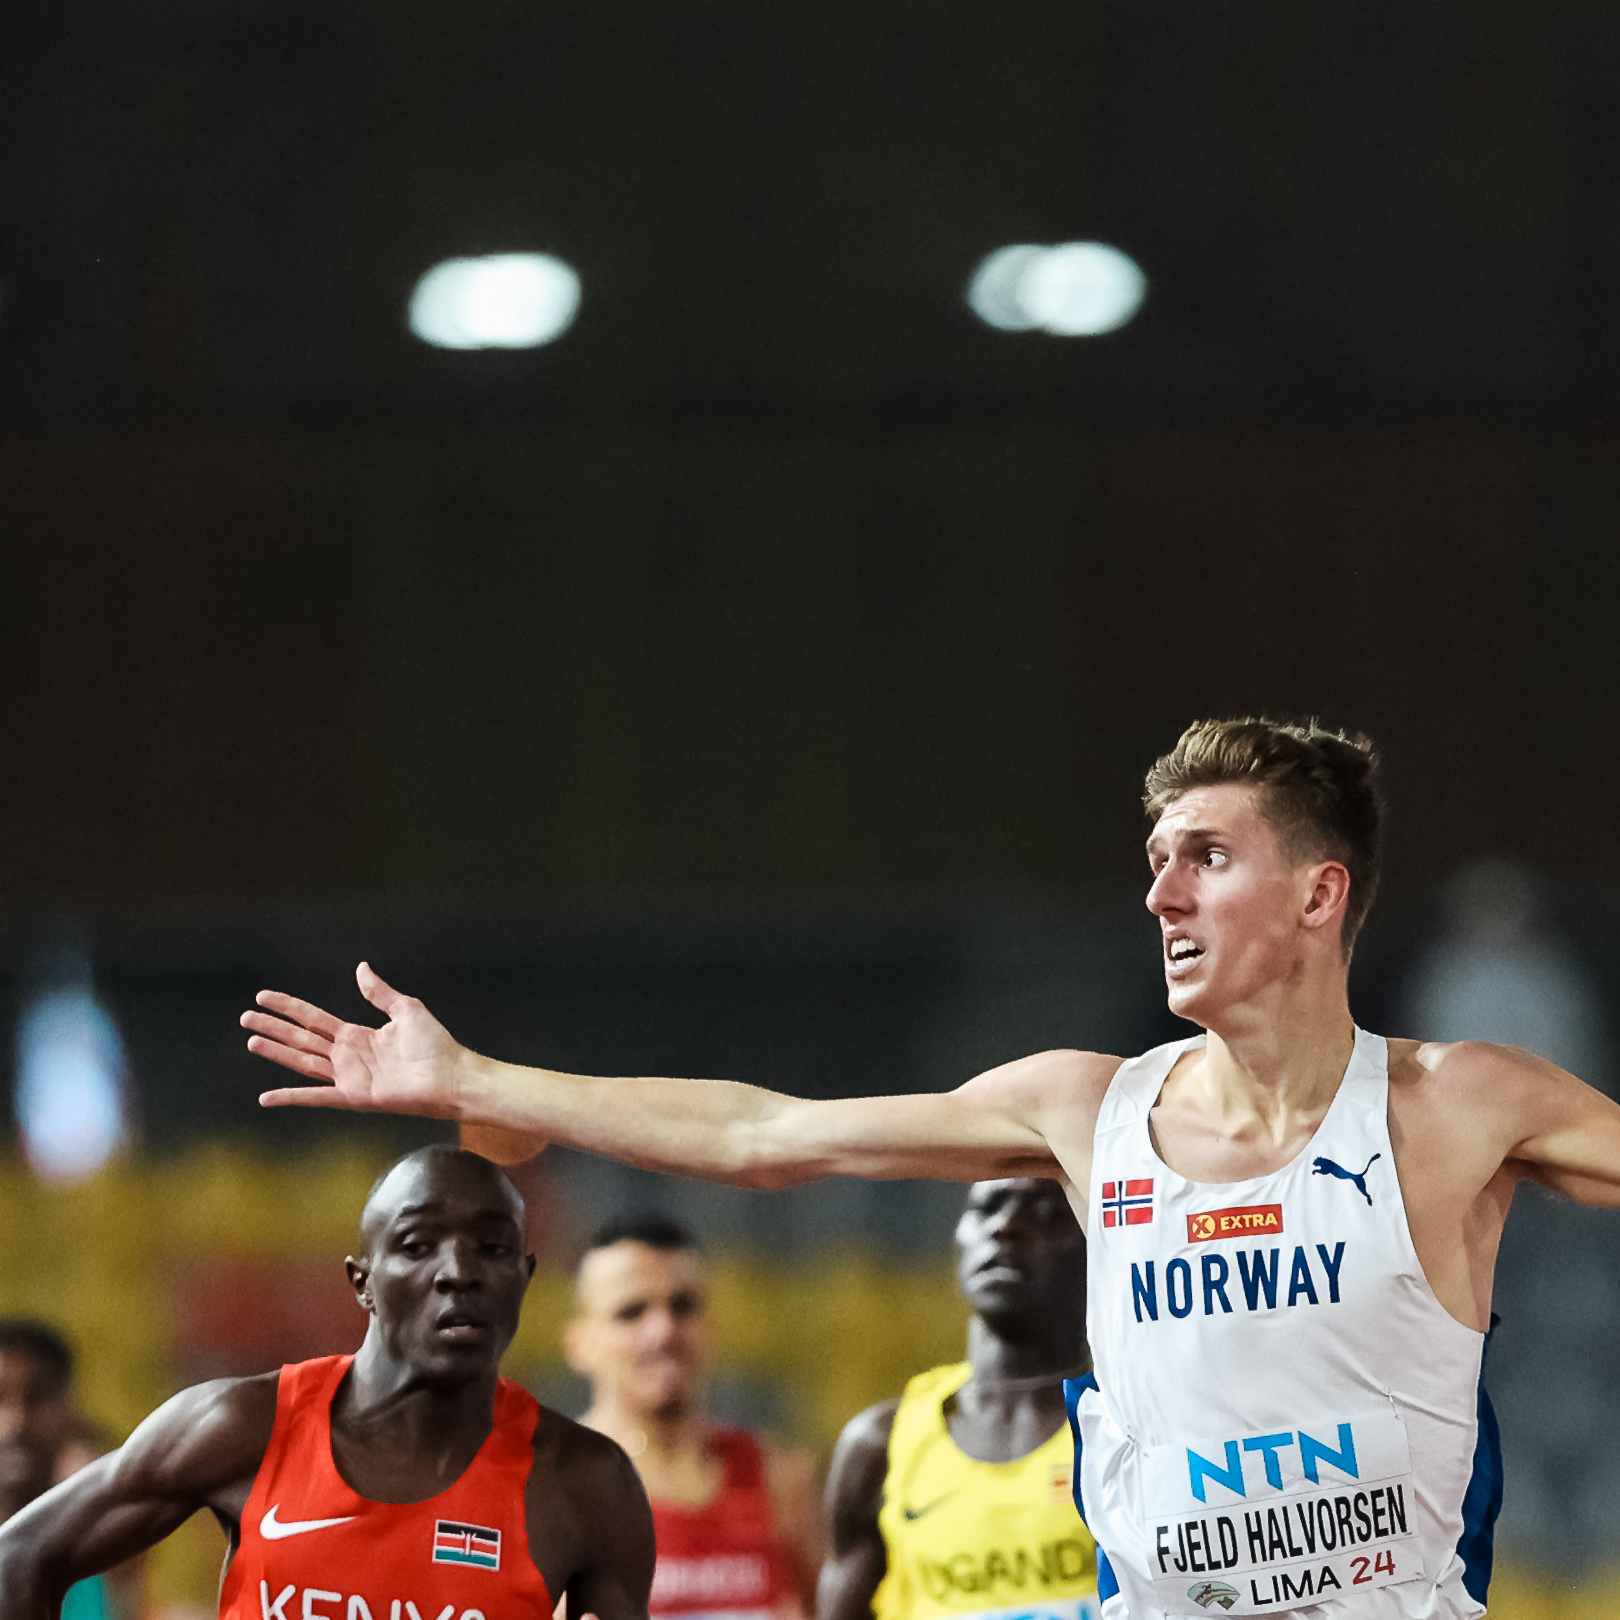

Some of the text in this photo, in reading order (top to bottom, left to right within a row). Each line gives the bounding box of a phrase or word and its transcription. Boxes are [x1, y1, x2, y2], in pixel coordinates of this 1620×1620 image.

[1220, 1212, 1278, 1232] EXTRA
[1130, 1241, 1346, 1323] NORWAY
[1185, 1422, 1359, 1504] NTN
[1155, 1483, 1408, 1575] FJELD HALVORSEN
[918, 1539, 1097, 1602] UGAND
[1250, 1550, 1397, 1607] LIMA 24
